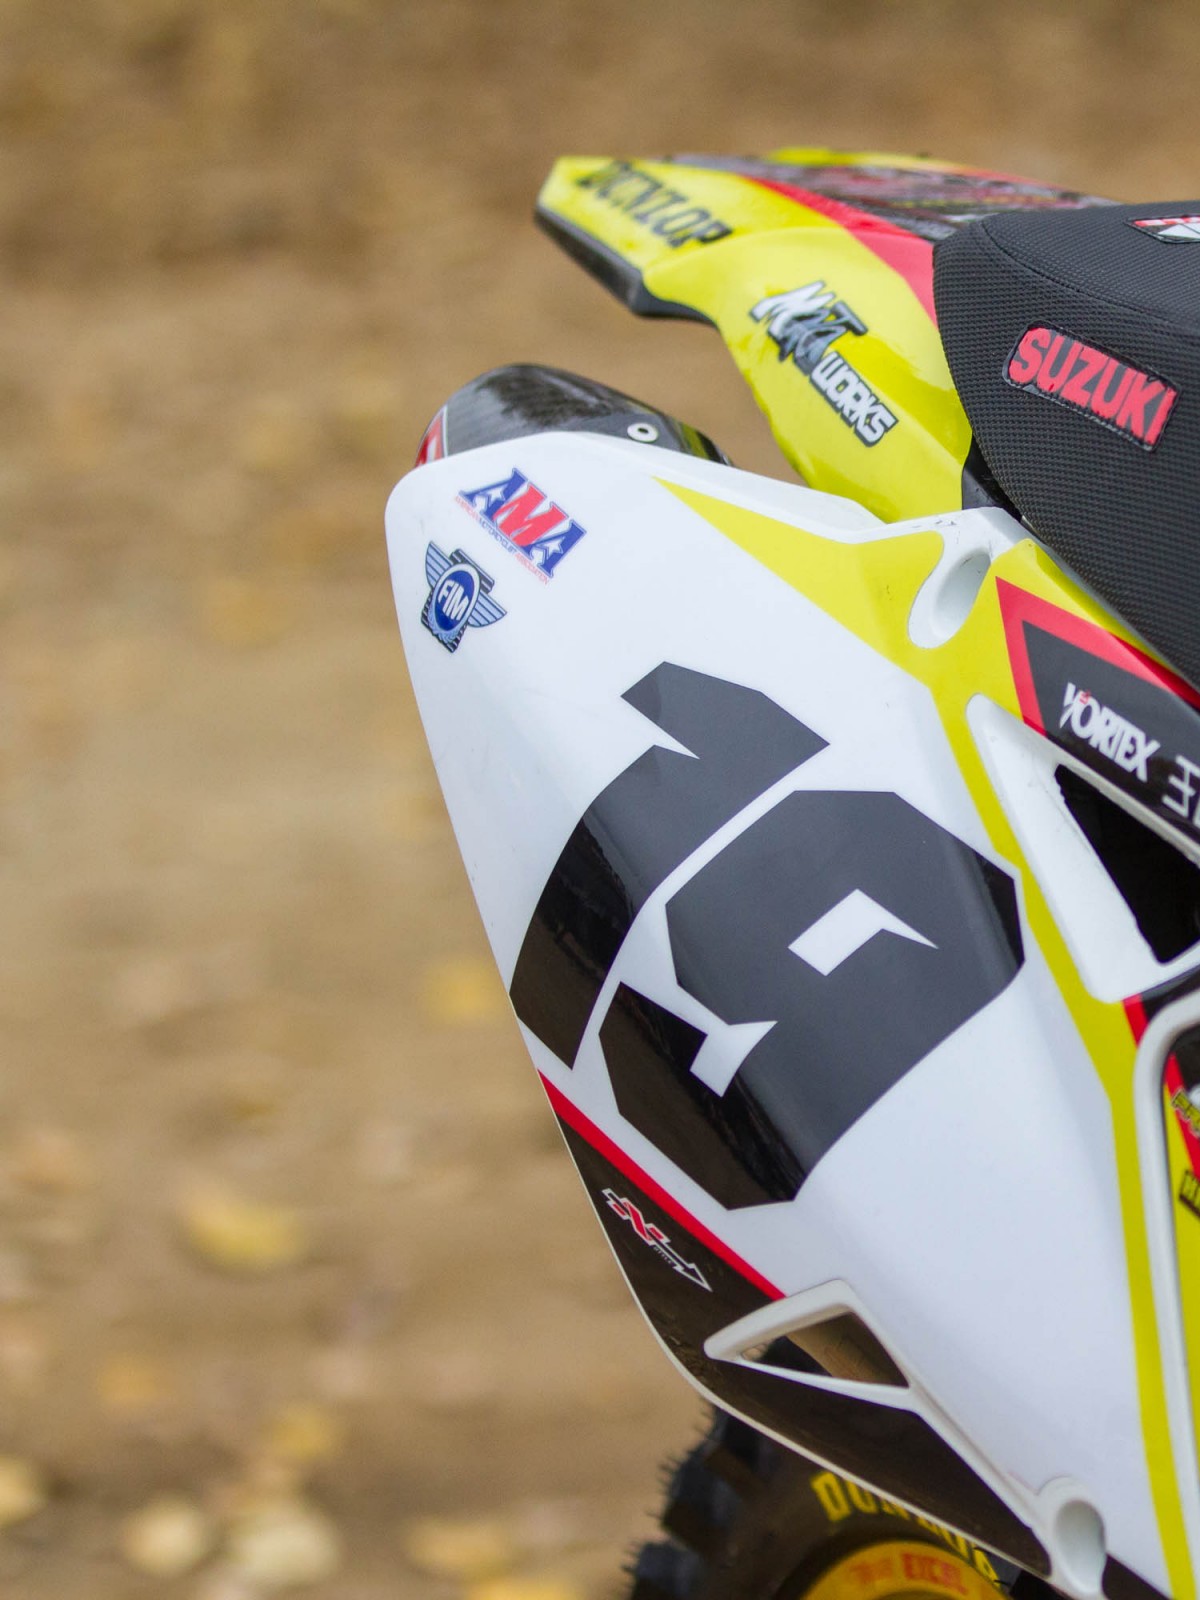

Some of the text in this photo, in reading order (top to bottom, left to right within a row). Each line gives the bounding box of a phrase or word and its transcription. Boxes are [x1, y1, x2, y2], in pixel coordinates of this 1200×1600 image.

[809, 351, 899, 447] WORKS
[1008, 326, 1177, 445] SUZUKI
[459, 467, 587, 579] AMA
[437, 579, 471, 621] FIM
[1059, 682, 1161, 783] VORTEX
[509, 661, 1026, 1211] 19
